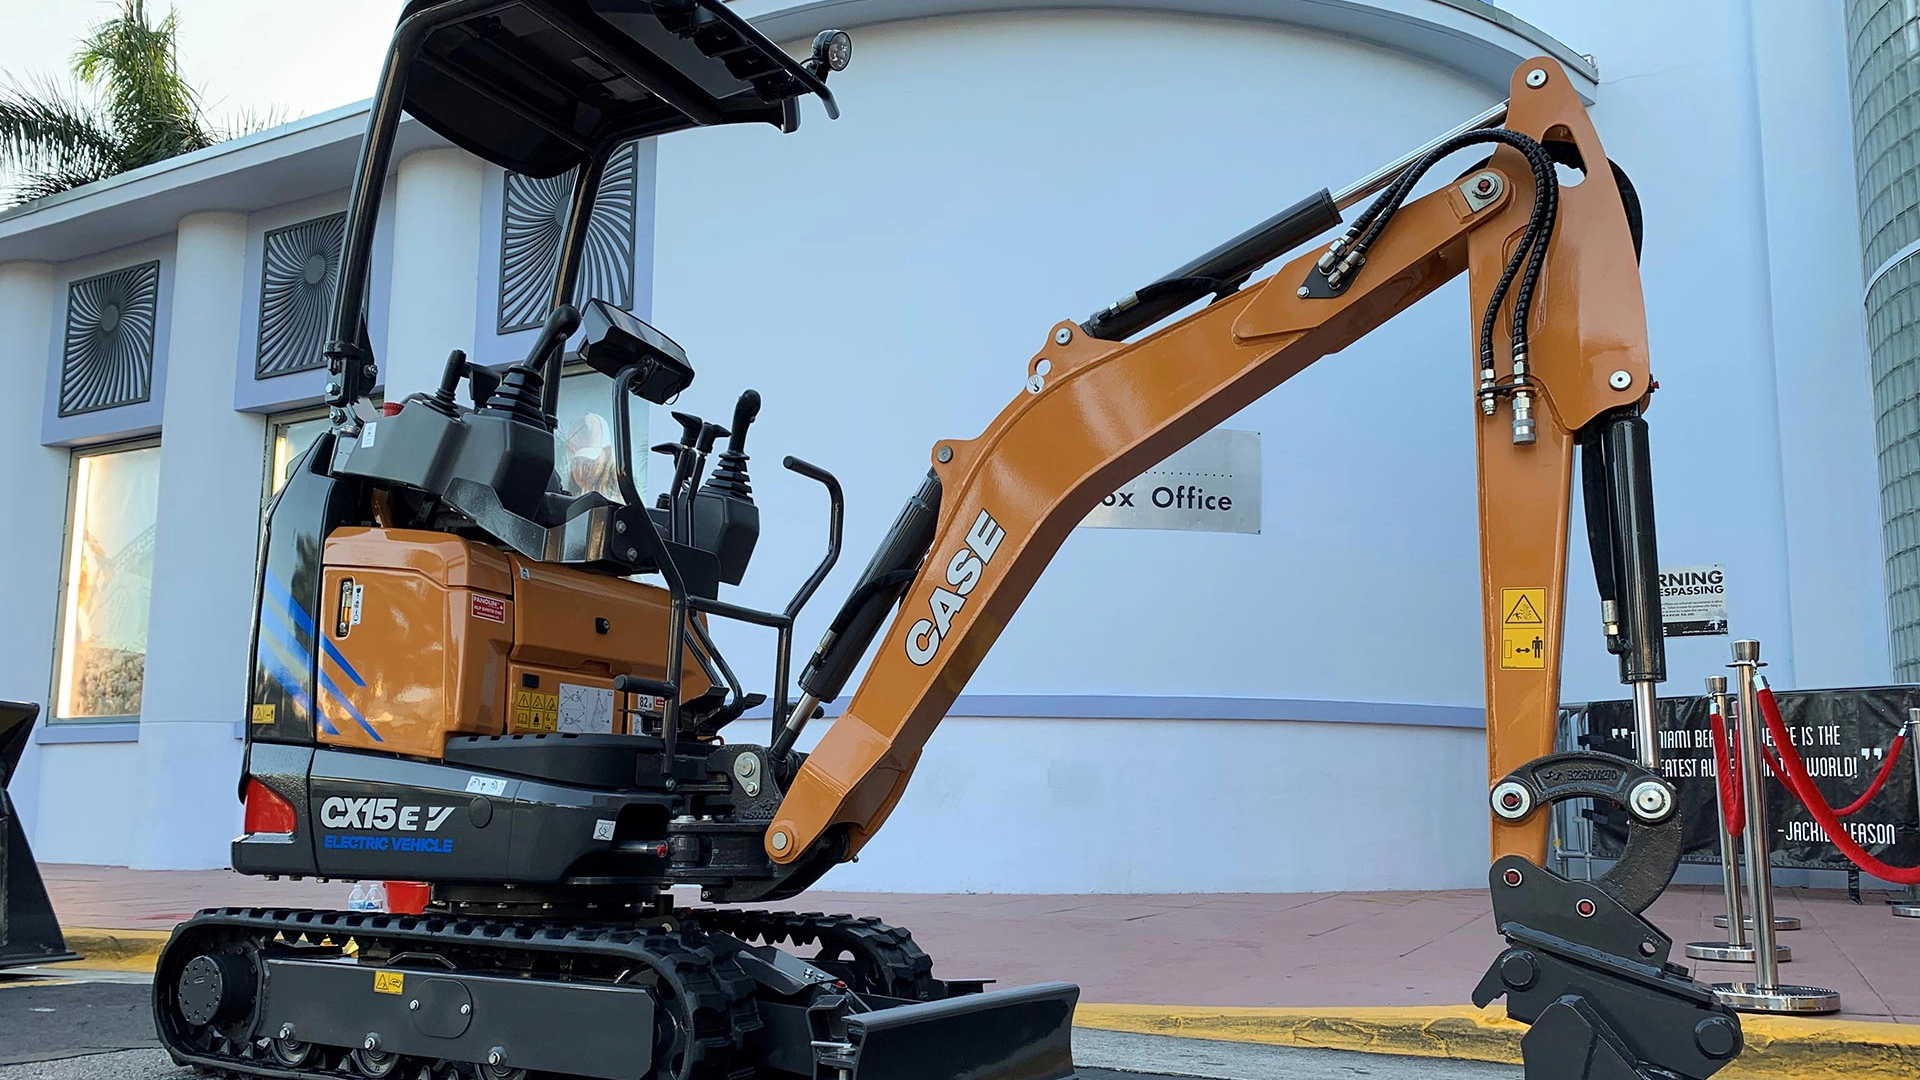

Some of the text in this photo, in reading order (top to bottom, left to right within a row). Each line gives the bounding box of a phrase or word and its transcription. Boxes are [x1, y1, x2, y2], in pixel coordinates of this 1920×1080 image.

[1101, 485, 1233, 511] ox Office
[905, 507, 1007, 667] CASE
[1658, 570, 1724, 587] RNING
[1659, 585, 1725, 597] ESPASSING
[639, 696, 648, 708] 82
[1801, 726, 1814, 746] IS
[1817, 725, 1841, 746] THE
[1660, 758, 1697, 778] EATEST
[323, 834, 455, 854] ELECTRIC VEHICLE
